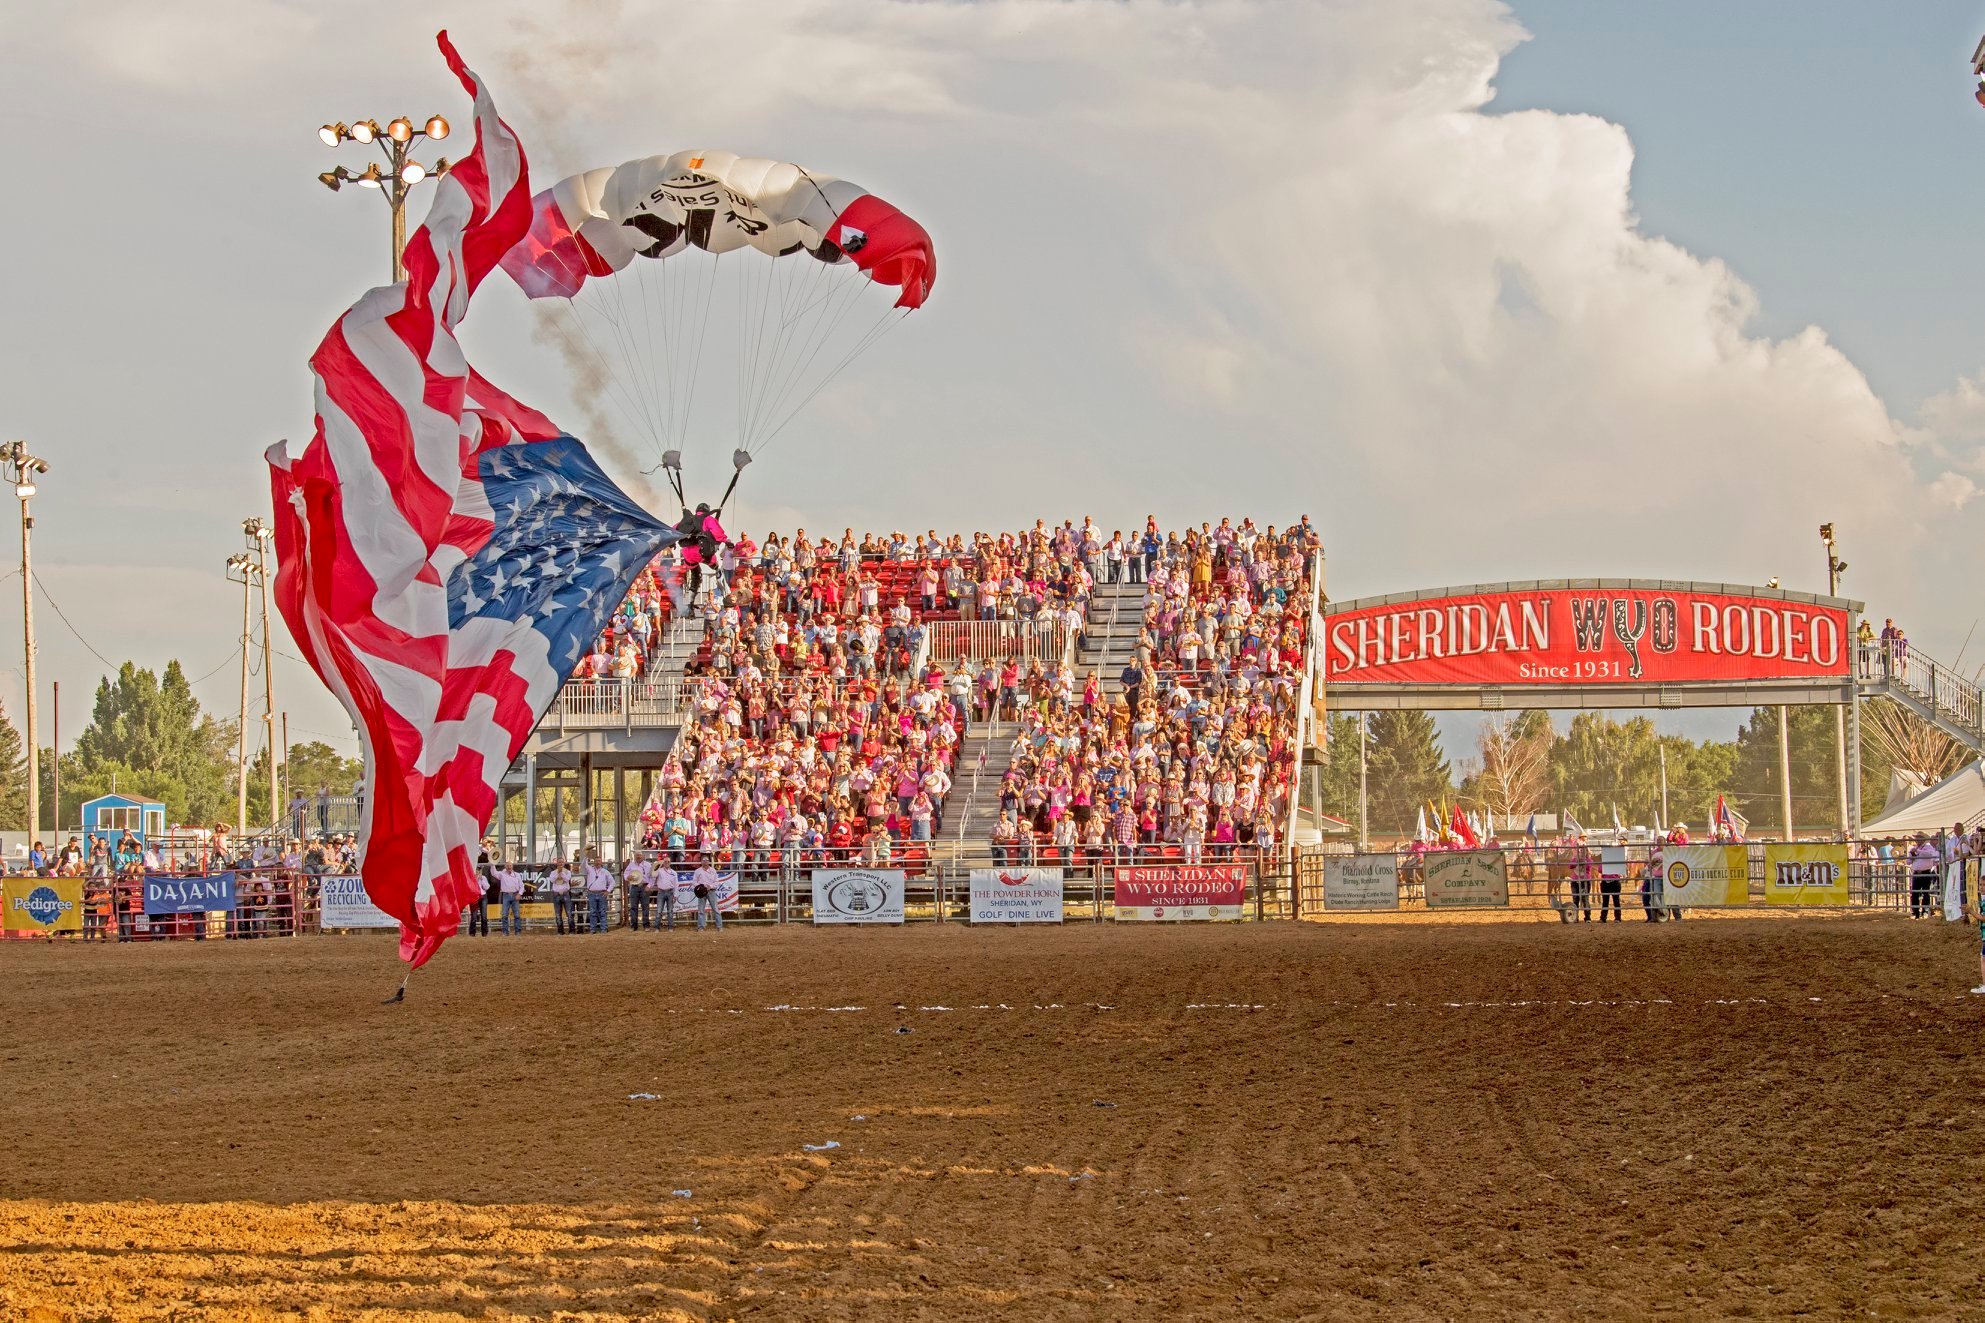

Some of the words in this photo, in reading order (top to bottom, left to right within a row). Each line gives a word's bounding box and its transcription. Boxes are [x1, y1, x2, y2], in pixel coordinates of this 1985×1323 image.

[651, 189, 720, 208] Sales
[1332, 599, 1551, 674] SHERIDAN
[1570, 597, 1678, 679] WYO
[1691, 600, 1839, 667] RODEO
[1519, 662, 1569, 679] Since
[1573, 661, 1621, 678] 1931
[1342, 864, 1373, 877] Diamond
[1374, 864, 1394, 875] Cross
[1428, 857, 1472, 878] SHERIDAN
[1477, 858, 1499, 877] SEED
[1691, 870, 1705, 879] GOLD
[1706, 869, 1728, 879] BUCKLE
[1730, 868, 1744, 878] CLUB
[822, 873, 848, 891] Western
[849, 871, 880, 881] Transport
[880, 878, 892, 890] LLC
[1135, 868, 1226, 881] SHERIDAN
[150, 881, 227, 904] DASANI
[338, 879, 364, 893] ZOW
[1127, 883, 1167, 894] WYO
[1172, 881, 1235, 894] RODEO
[327, 894, 366, 905] RECYCLING
[973, 890, 990, 898] THE
[993, 890, 1032, 898] POWDER
[1033, 889, 1060, 898] HORN
[14, 897, 73, 913] Pedigree
[1152, 897, 1185, 905] SINCE
[1188, 896, 1209, 904] 1931
[979, 911, 1003, 919] GOLF
[1036, 910, 1055, 918] LIVE
